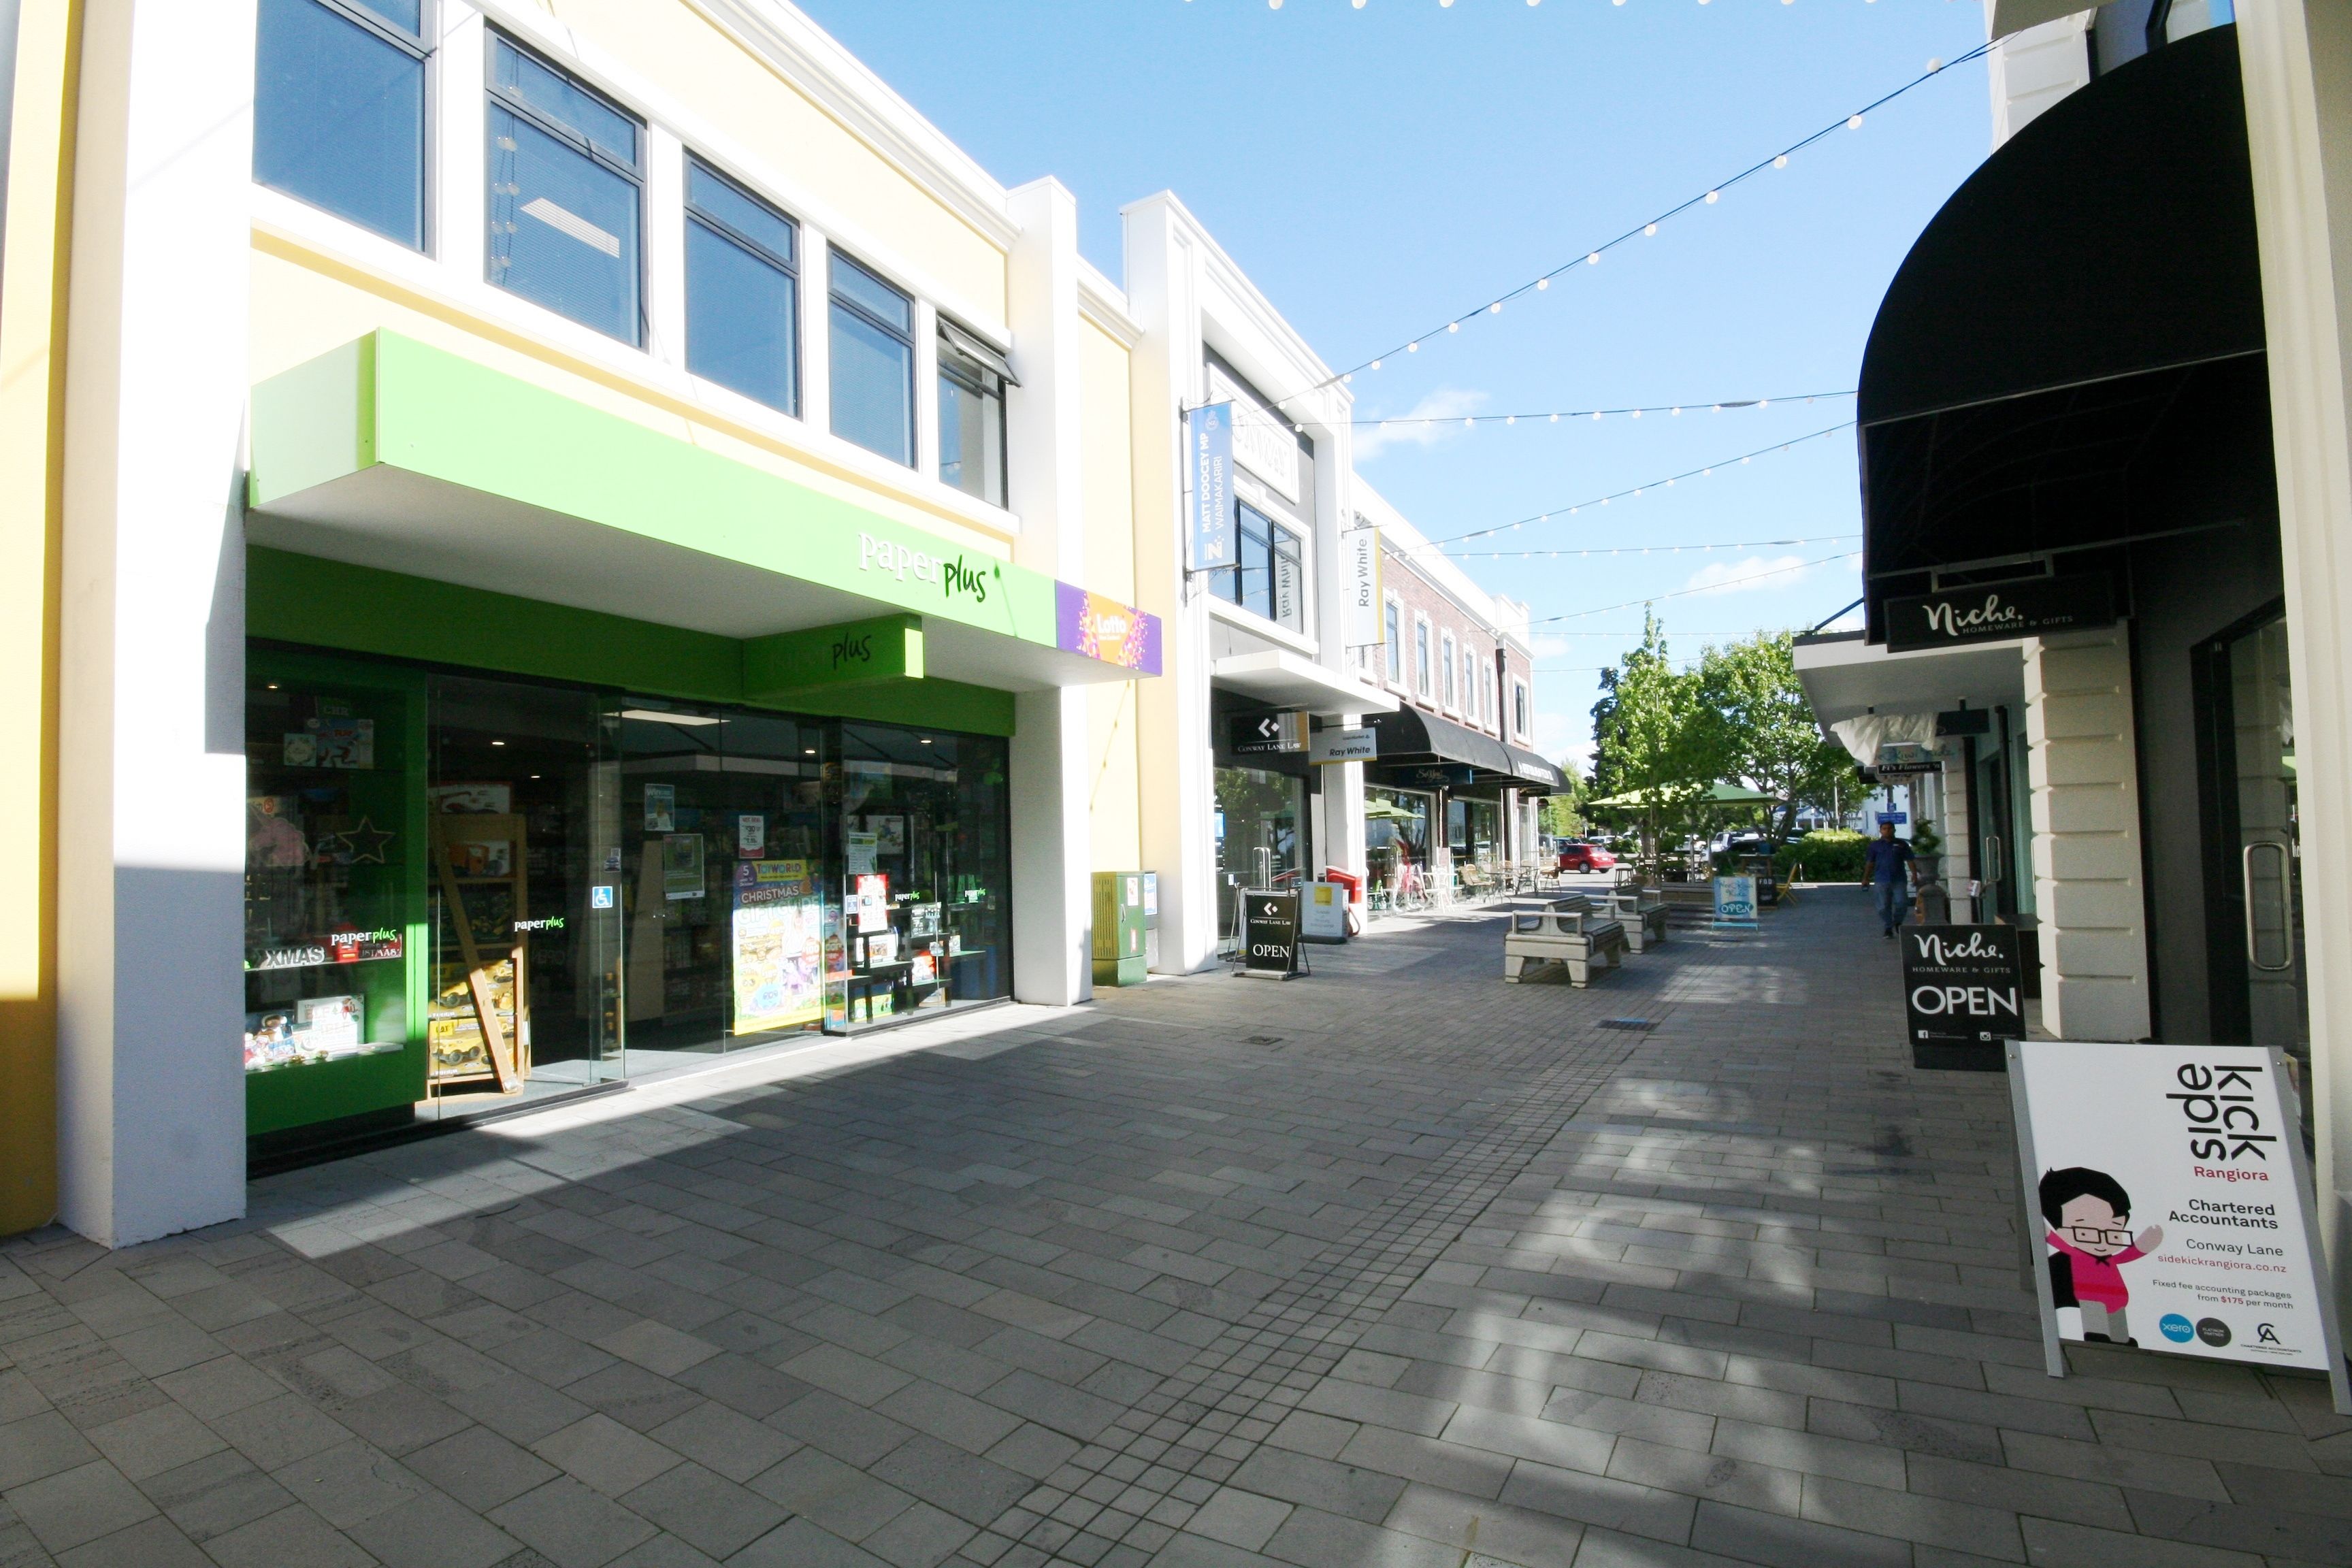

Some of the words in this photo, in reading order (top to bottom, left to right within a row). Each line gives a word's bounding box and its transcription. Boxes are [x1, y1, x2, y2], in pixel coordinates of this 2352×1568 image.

[1199, 433, 1209, 450] MP
[1200, 451, 1210, 501] DOOCEY
[1213, 456, 1224, 530] WAIMAKARIRI
[1202, 503, 1211, 534] MATT
[1356, 538, 1367, 578] White
[1358, 581, 1371, 606] Ray
[1096, 613, 1126, 634] Lotto
[1962, 621, 2024, 634] HOMEWARE
[2042, 615, 2074, 625] GIFTS
[1329, 748, 1345, 757] Ray
[1347, 746, 1371, 755] White
[742, 865, 749, 876] 5
[756, 863, 801, 874] TOYWORLD
[741, 885, 799, 904] CHRISTMAS
[1720, 903, 1751, 913] OPEN
[265, 946, 325, 968] XMAS
[1252, 944, 1290, 958] OPEN
[1911, 985, 2018, 1017] OPEN
[2165, 1063, 2226, 1162] side
[2213, 1064, 2276, 1161] kick
[2193, 1165, 2269, 1183] Rangiora
[2188, 1198, 2275, 1216] Chartered
[2168, 1210, 2278, 1230] Accountants
[2186, 1238, 2242, 1256] Conway
[2247, 1243, 2283, 1256] Lane
[2157, 1253, 2287, 1273] sidekickrangiora.co.nz
[2152, 1279, 2176, 1288] Fixed
[2178, 1281, 2193, 1289] fee
[2194, 1284, 2245, 1296] accounting
[2247, 1288, 2291, 1300] packages
[2197, 1293, 2219, 1303] from
[2220, 1294, 2244, 1305] $175
[2246, 1298, 2261, 1307] per
[2263, 1301, 2293, 1310] month
[2161, 1322, 2191, 1334] xero
